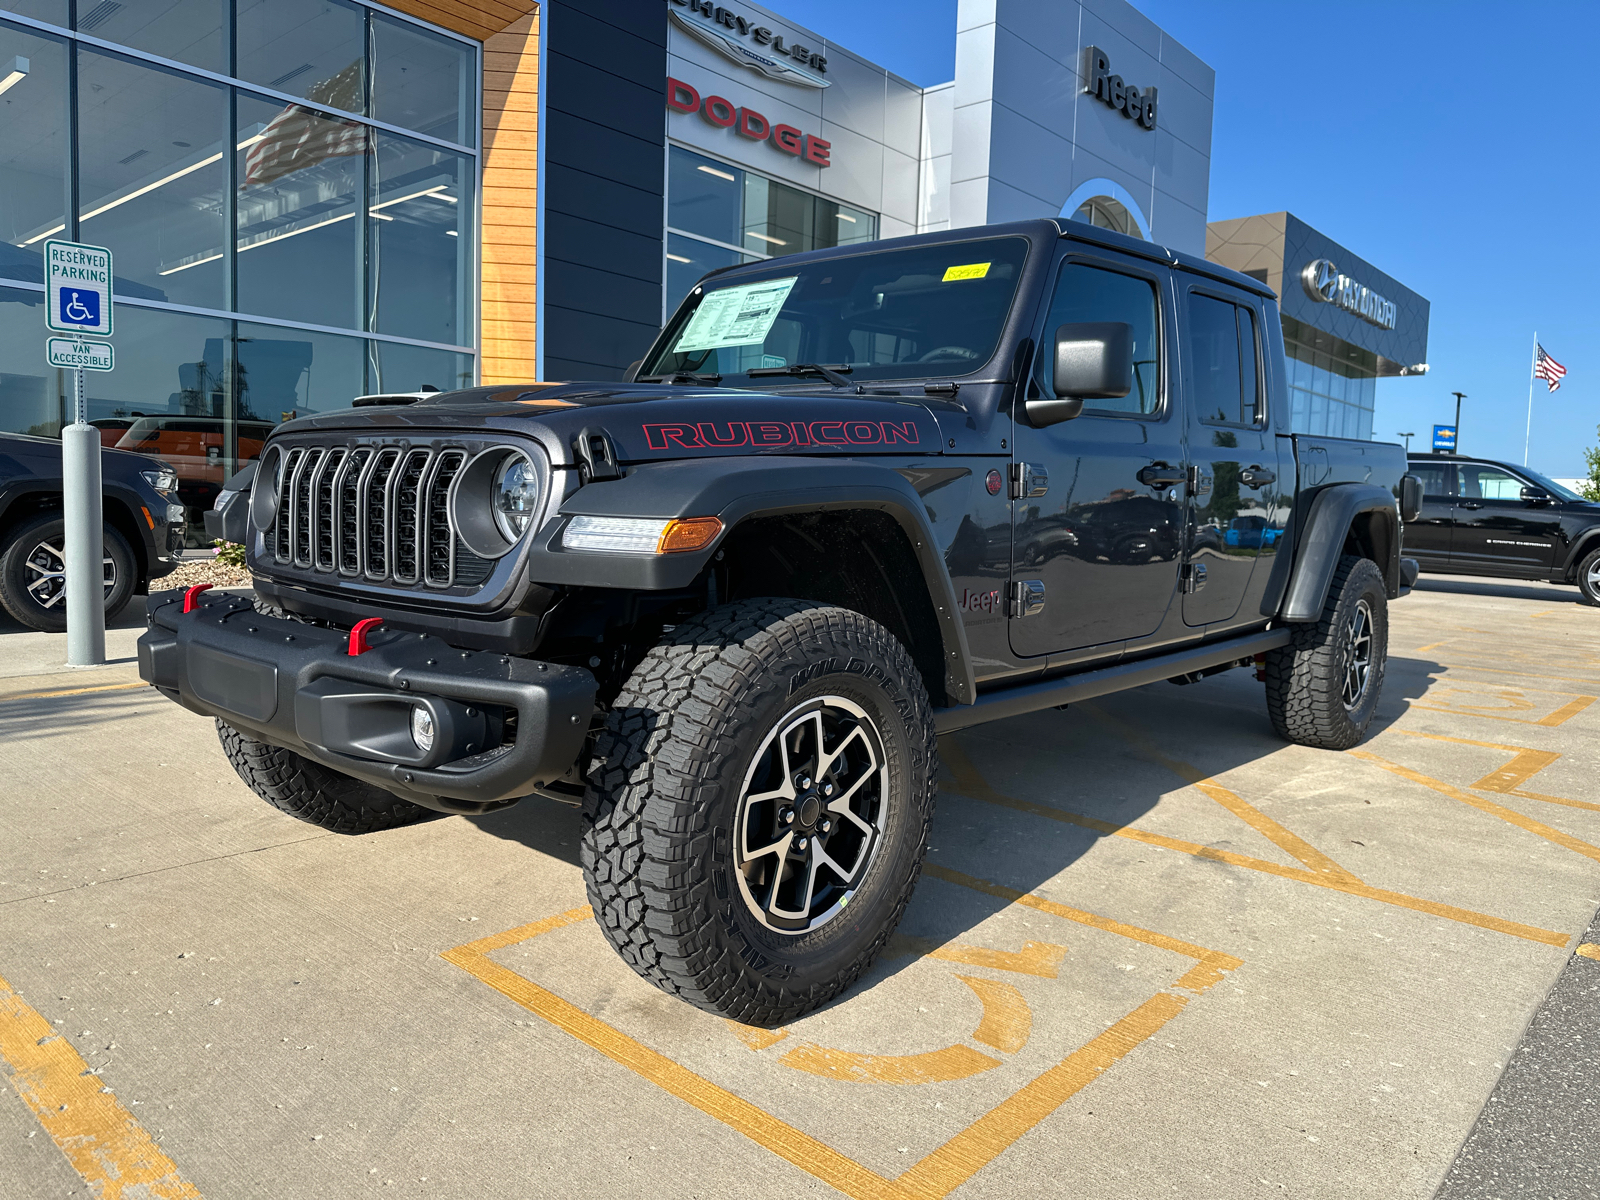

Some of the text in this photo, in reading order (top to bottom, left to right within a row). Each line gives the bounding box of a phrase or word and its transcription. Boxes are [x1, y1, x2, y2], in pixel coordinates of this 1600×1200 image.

[671, 0, 827, 72] HRYSLER
[1084, 45, 1158, 131] Reed
[666, 76, 831, 168] DODGE
[52, 249, 105, 267] RESERVED
[52, 265, 106, 283] PARKING
[1338, 274, 1397, 330] HYUNDAI
[53, 353, 109, 366] ACCESSIBLE
[72, 344, 91, 354] VAN
[642, 421, 920, 449] RUBICON
[958, 588, 1001, 614] Jeep
[788, 657, 920, 739] WILDPEAK
